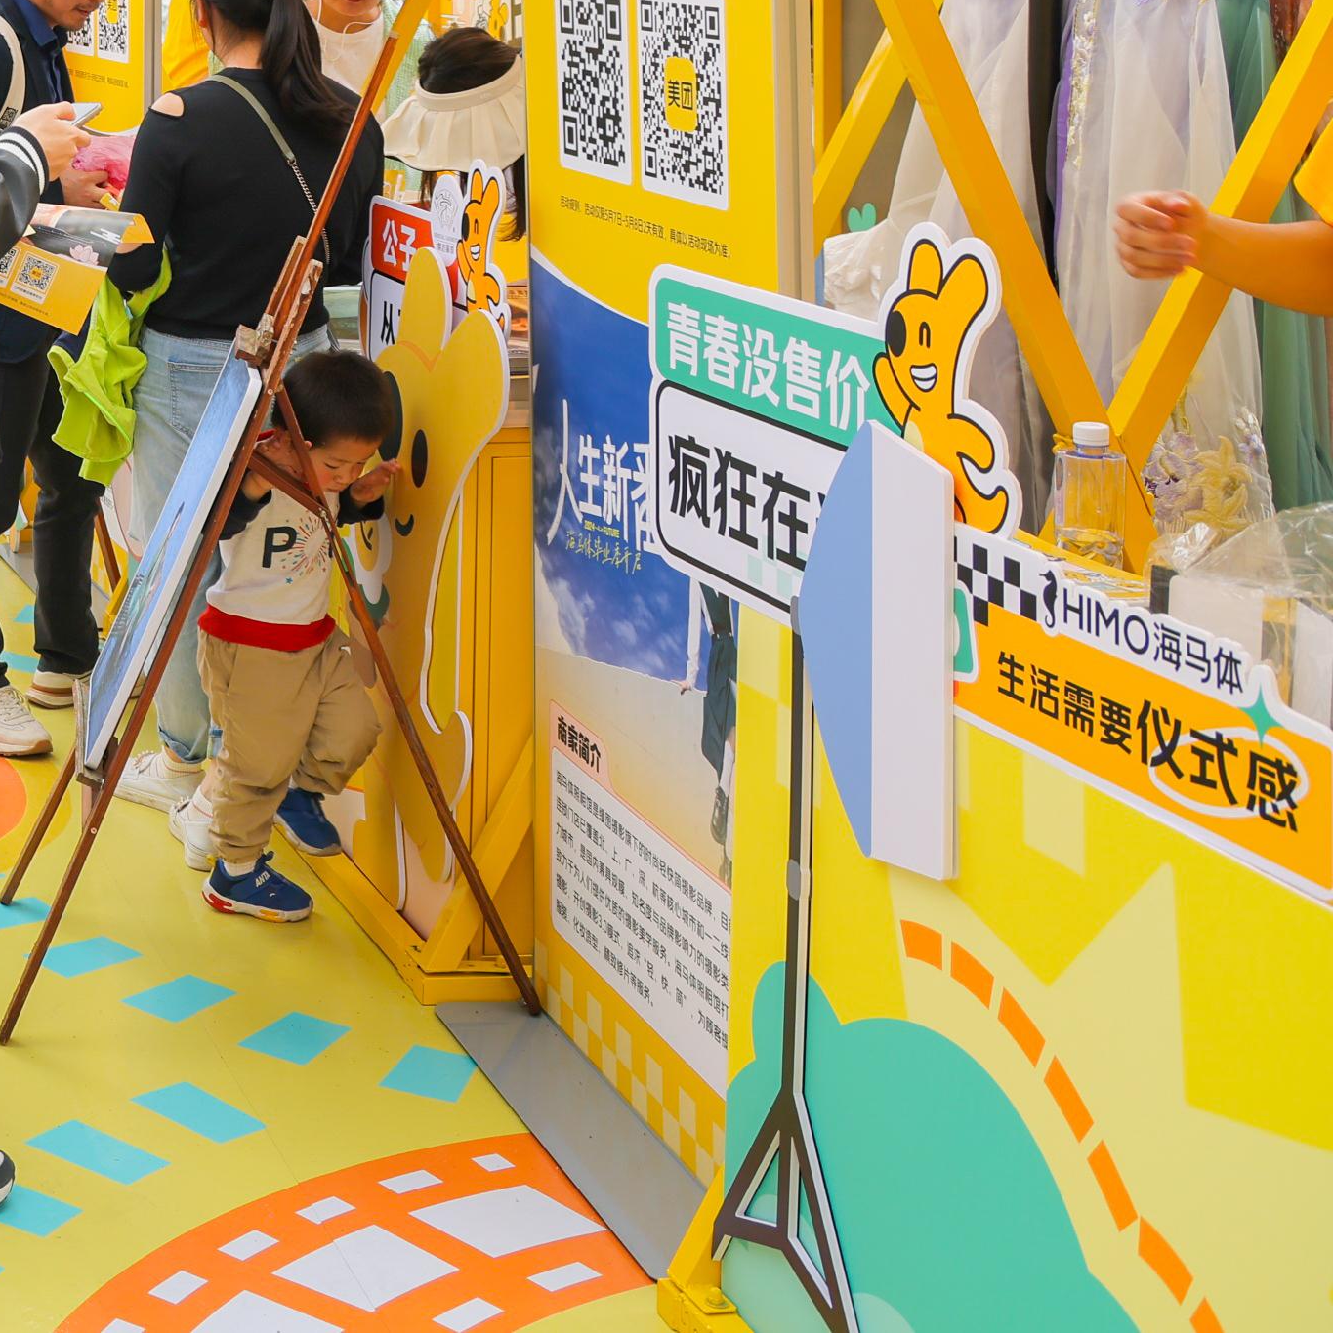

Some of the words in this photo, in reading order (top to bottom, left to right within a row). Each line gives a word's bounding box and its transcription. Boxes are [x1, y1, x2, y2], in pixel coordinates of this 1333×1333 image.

[667, 79, 694, 111] 美团
[380, 299, 400, 346] 从
[666, 301, 871, 432] 青春没售价
[668, 434, 827, 573] 疯狂在
[1062, 587, 1244, 696] HIMO海马体
[557, 714, 602, 774] 商家简介
[997, 651, 1300, 834] 生活需要仪式感
